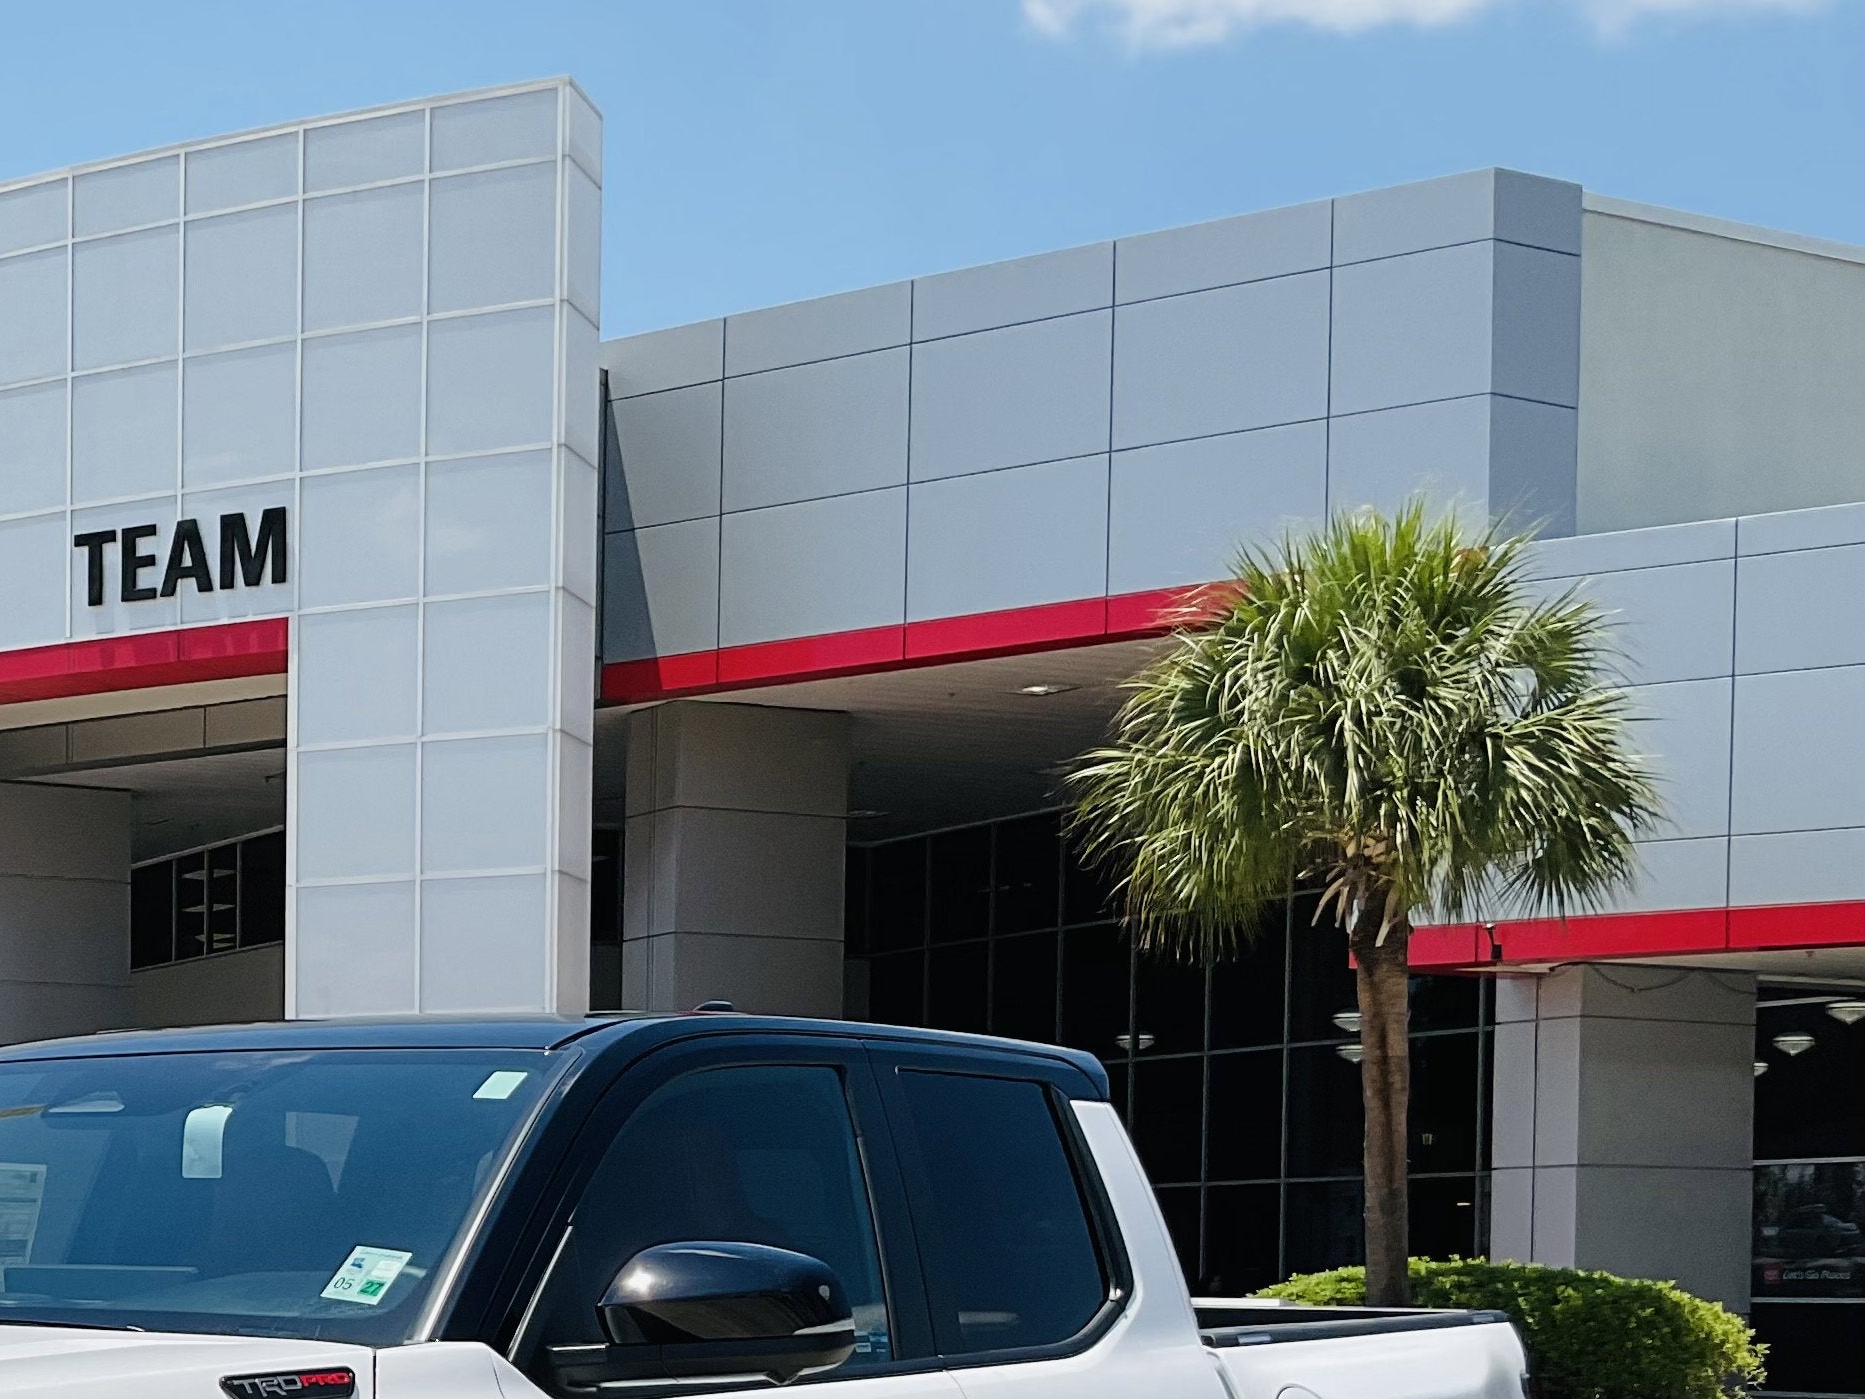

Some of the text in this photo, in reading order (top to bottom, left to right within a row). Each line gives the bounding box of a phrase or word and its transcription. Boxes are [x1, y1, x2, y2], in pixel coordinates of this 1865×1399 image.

[73, 506, 287, 607] TEAM
[334, 1277, 385, 1295] 05 27
